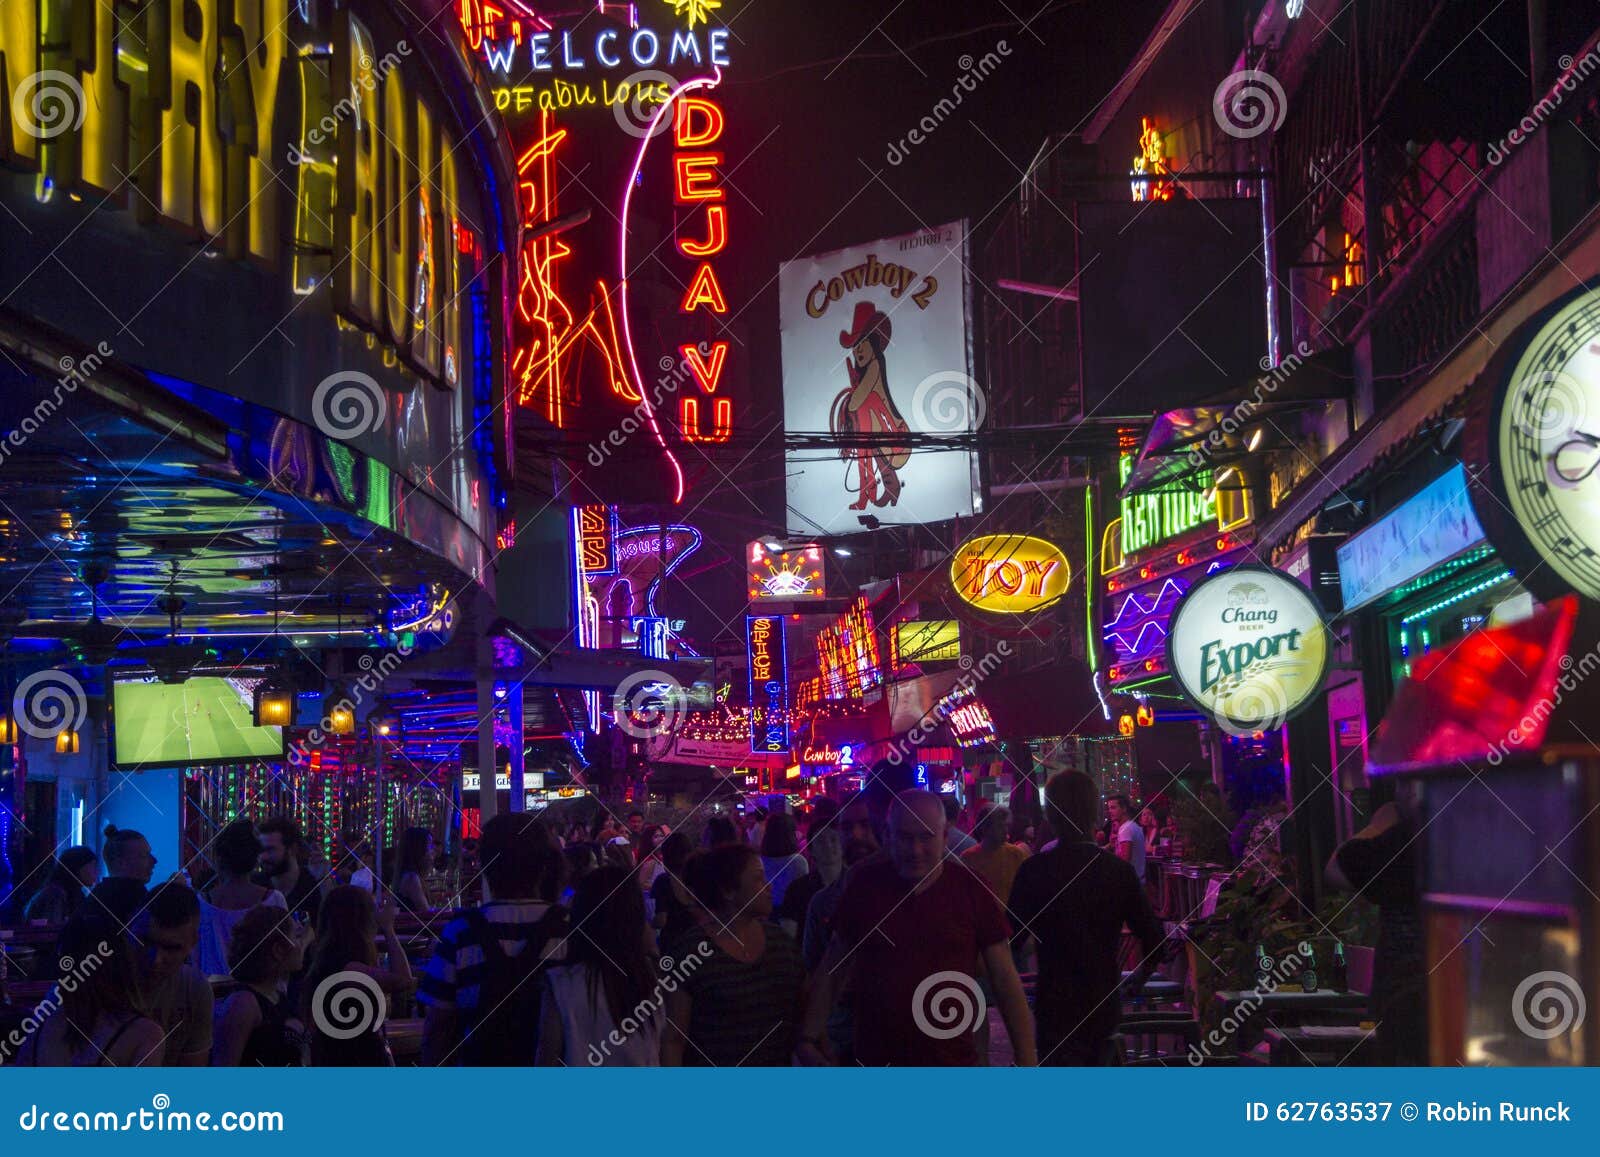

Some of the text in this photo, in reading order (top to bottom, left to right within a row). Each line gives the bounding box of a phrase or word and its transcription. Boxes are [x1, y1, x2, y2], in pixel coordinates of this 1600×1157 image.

[483, 28, 730, 74] WELCOME
[675, 97, 732, 444] DEJA VU
[805, 254, 938, 319] Cowboy 2
[966, 556, 1061, 598] TOY
[1221, 607, 1279, 624] Chang
[753, 618, 772, 680] SPICE
[1200, 627, 1301, 693] Export
[804, 743, 854, 765] Cowboy 2
